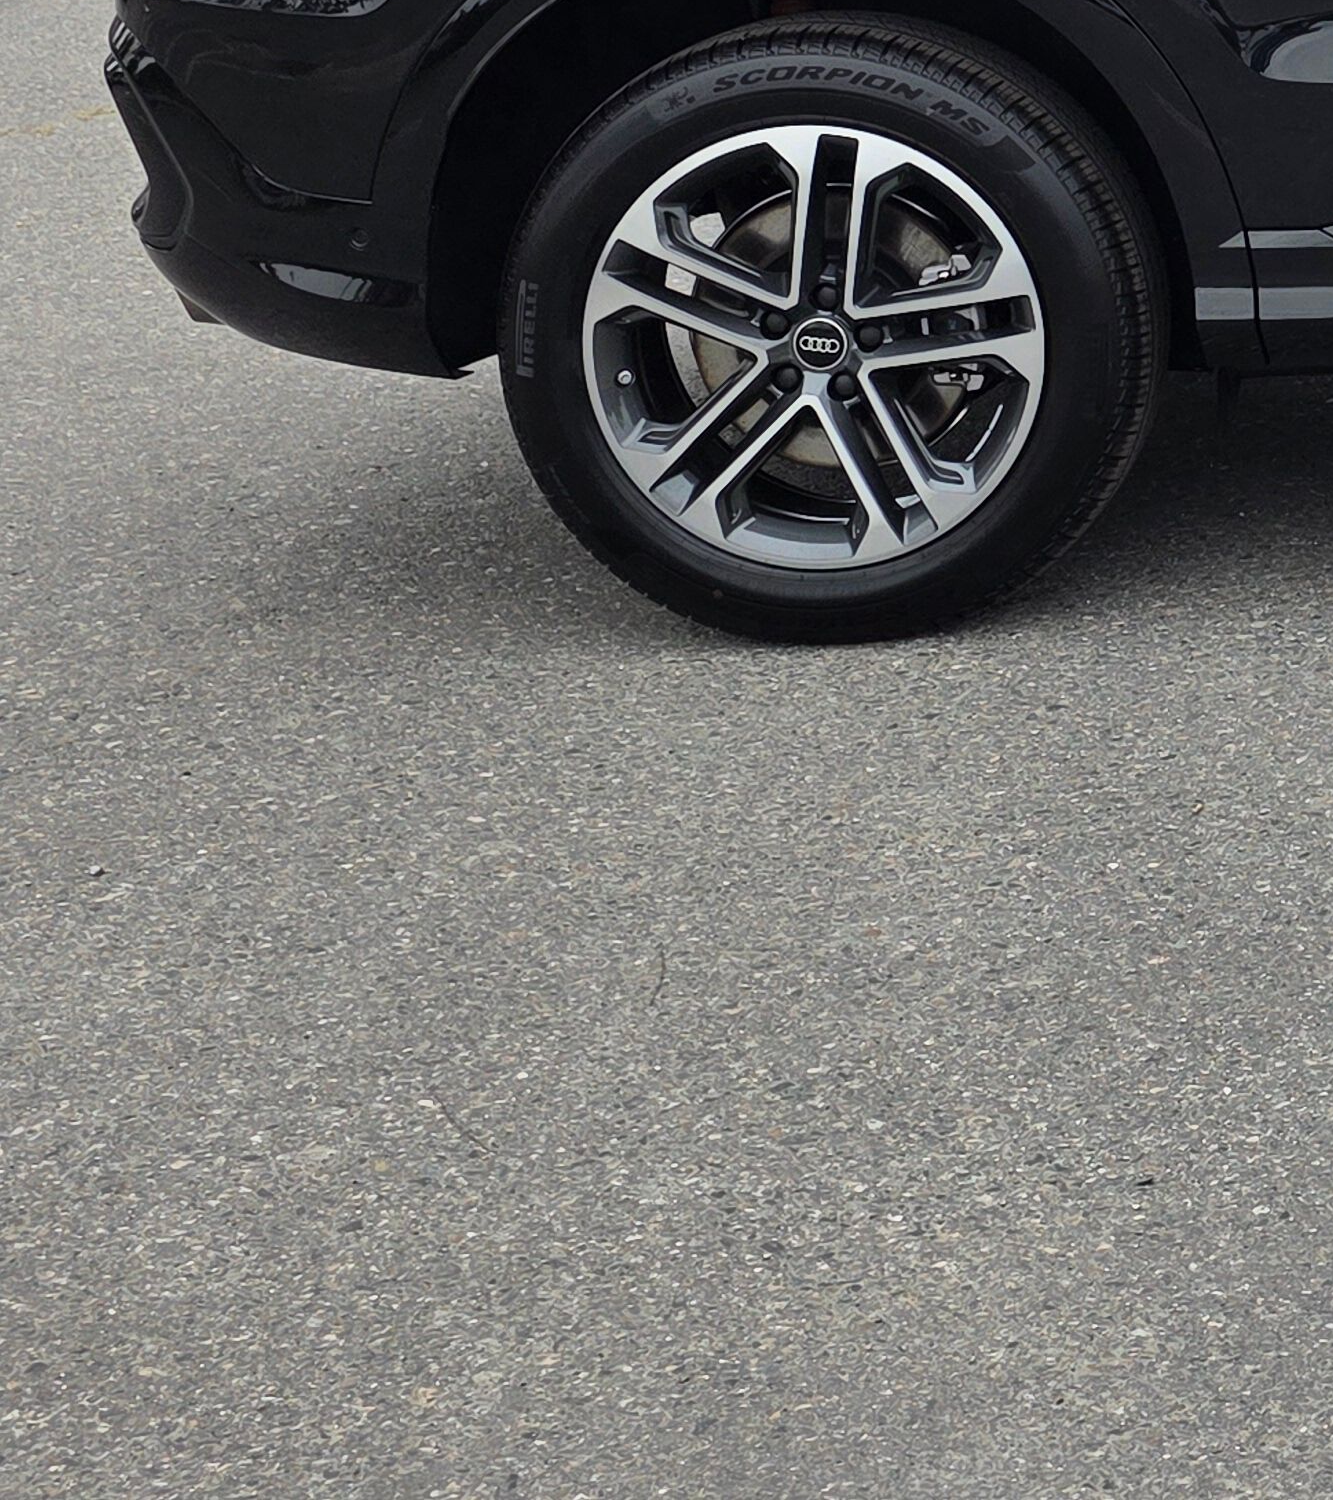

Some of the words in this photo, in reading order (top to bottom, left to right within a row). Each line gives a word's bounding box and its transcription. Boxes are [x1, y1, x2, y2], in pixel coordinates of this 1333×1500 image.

[712, 65, 923, 101] SCORPION
[929, 99, 993, 137] MS
[515, 278, 540, 379] PIRELLI
